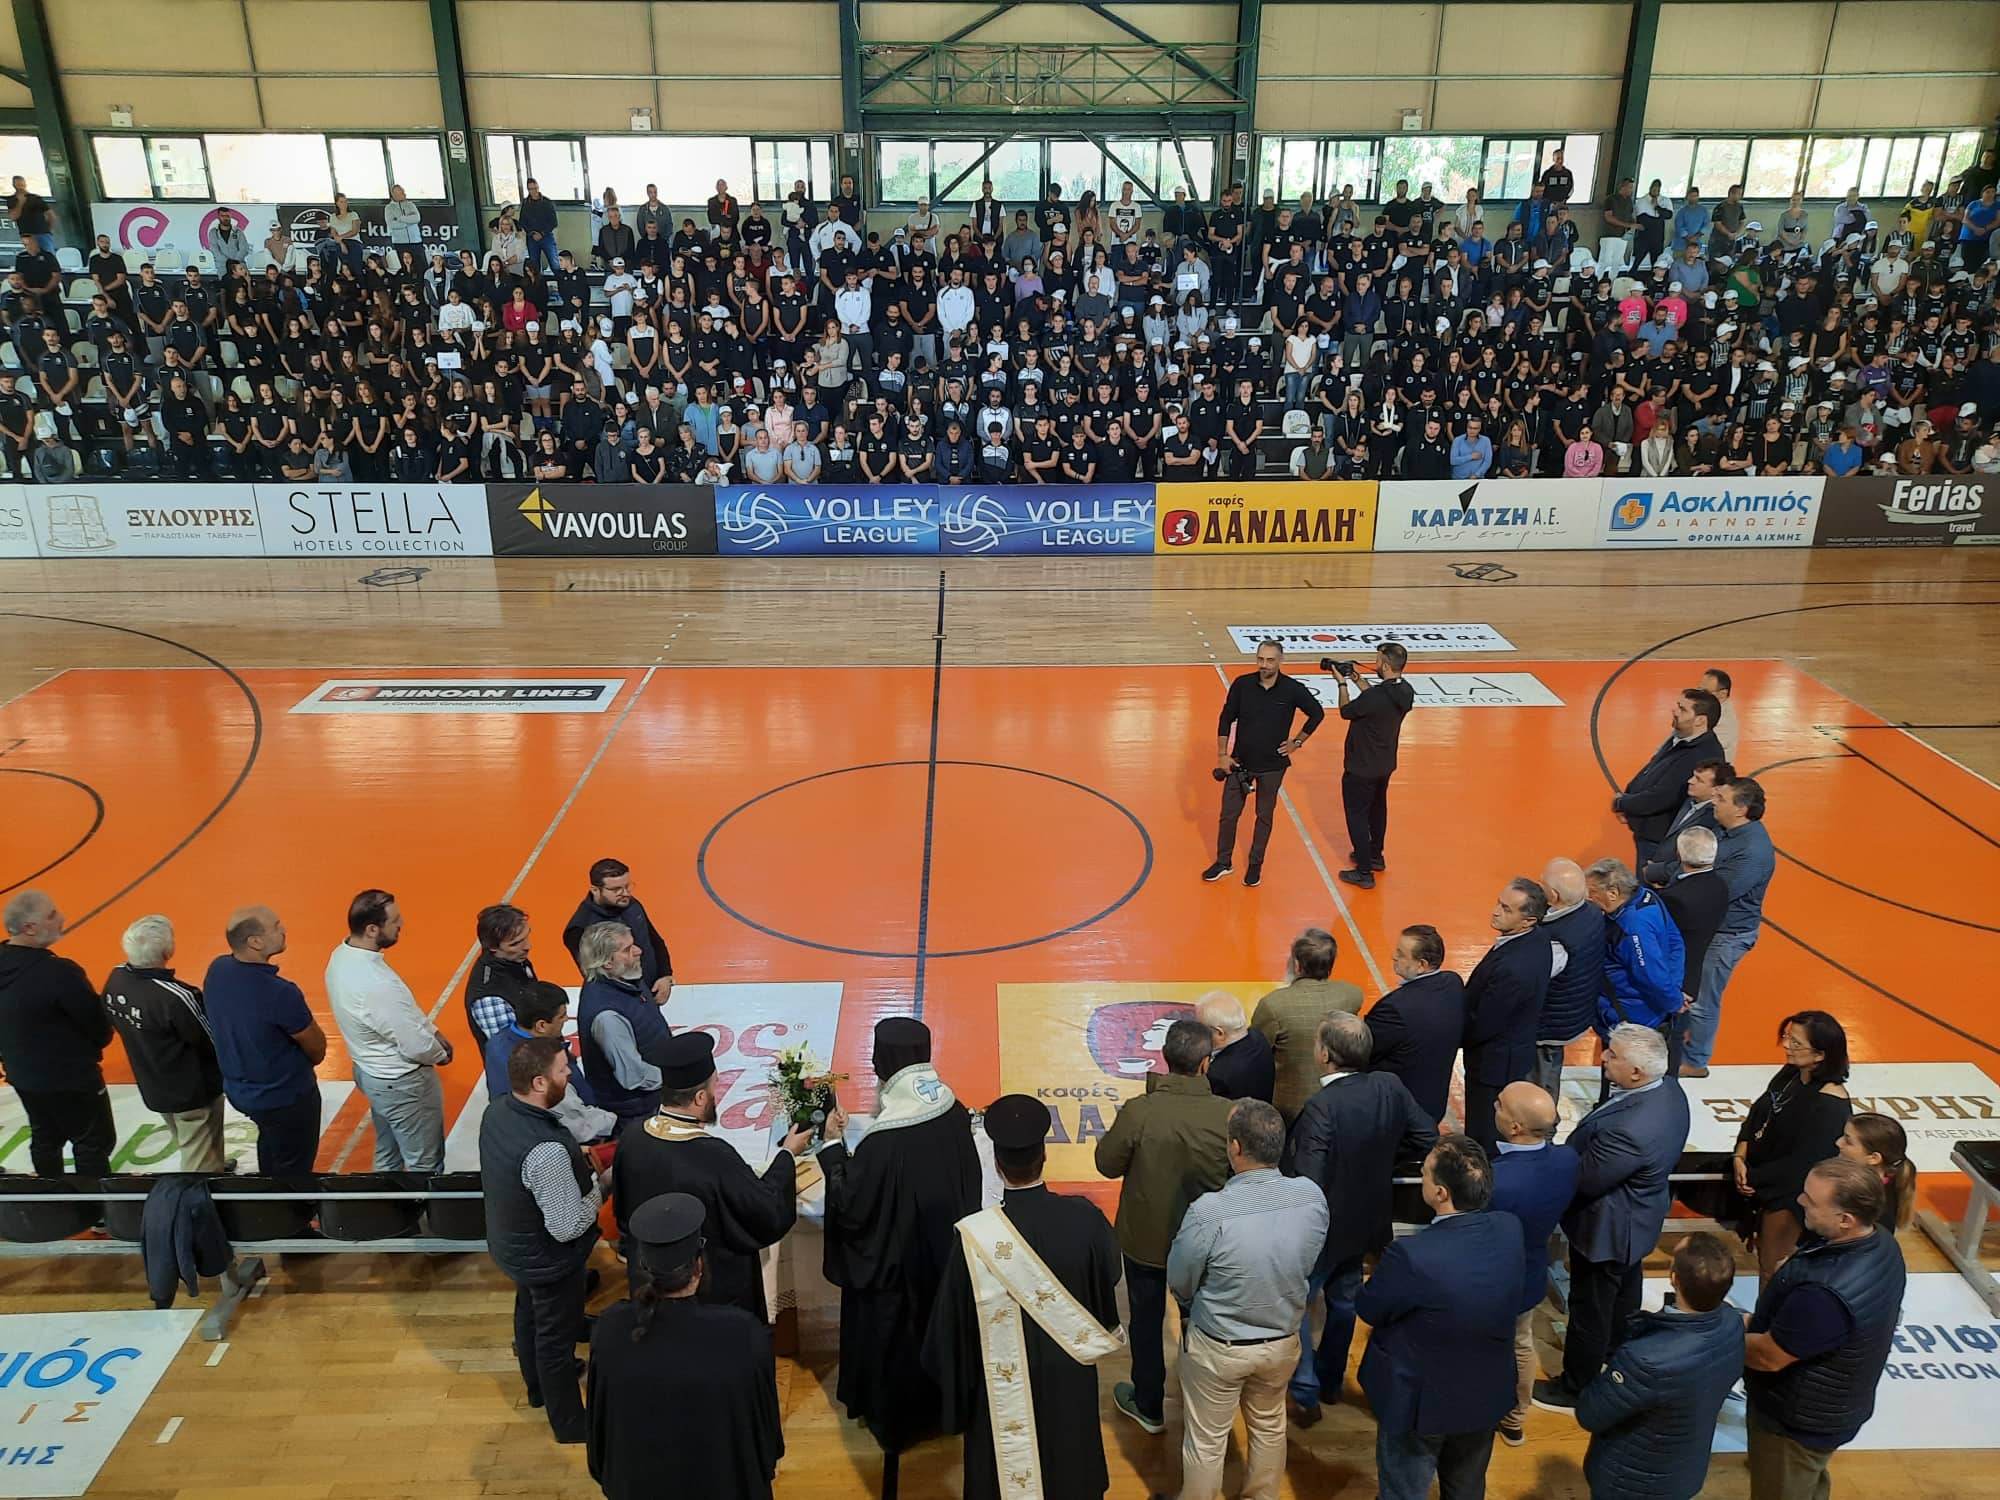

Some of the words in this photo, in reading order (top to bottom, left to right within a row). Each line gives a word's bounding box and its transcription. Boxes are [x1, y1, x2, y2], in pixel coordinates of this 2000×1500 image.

[1208, 494, 1244, 508] καφές
[1660, 490, 1812, 515] Ασκληπιός
[1892, 480, 1985, 512] Ferias
[126, 509, 255, 527] ΞΥΛΟΥΡΗΣ
[289, 491, 462, 534] STELLA
[805, 498, 934, 521] VOLLEY
[1026, 499, 1152, 523] VOLLEY
[1411, 507, 1529, 527] ΚΑΡΑΤΖΗ
[543, 512, 687, 539] VAVOULAS
[1203, 509, 1357, 544] ΔΑΝΔΑΛΗ
[1656, 517, 1807, 528] ΔΙΑΓΝΩΣΙΣ
[1948, 522, 1976, 533] travel
[823, 527, 917, 543] LEAGUE
[1042, 528, 1136, 545] LEAGUE
[1687, 534, 1751, 542] ΦΡΟΝΤΙΔΑ
[1755, 533, 1802, 541] ΑΙΧΜΗΣ
[293, 540, 353, 551] HOTELS
[362, 539, 464, 551] COLLECTION
[653, 541, 687, 551] GROUP
[376, 688, 507, 698] MINOAN
[511, 688, 596, 698] LINES
[1037, 1082, 1120, 1101] καφές
[1885, 1363, 2000, 1380] REGION
